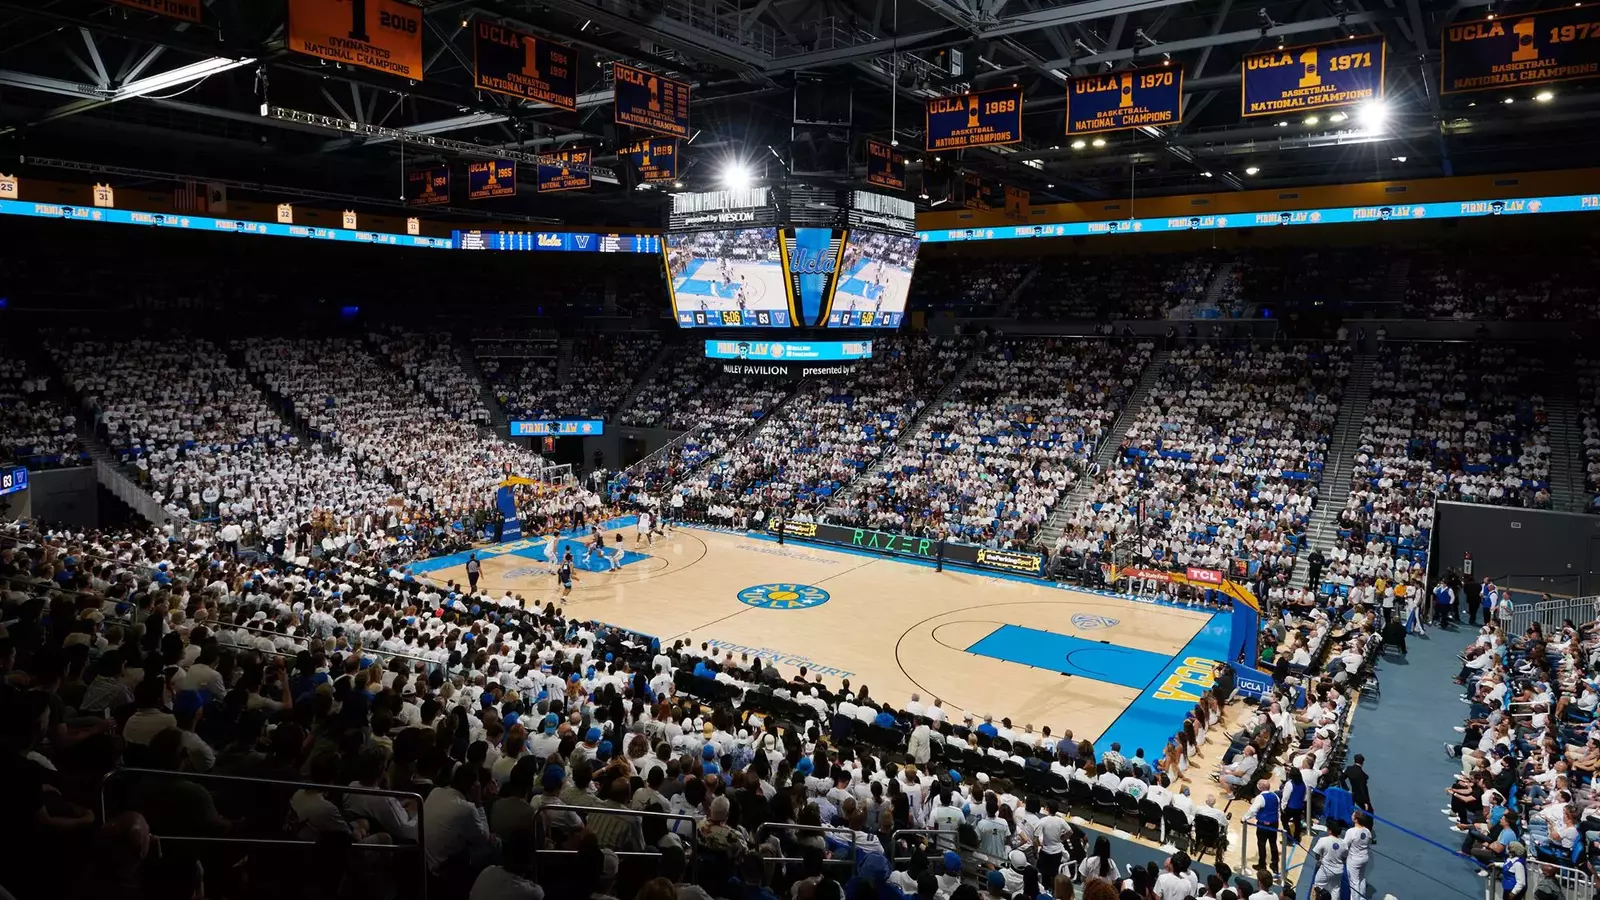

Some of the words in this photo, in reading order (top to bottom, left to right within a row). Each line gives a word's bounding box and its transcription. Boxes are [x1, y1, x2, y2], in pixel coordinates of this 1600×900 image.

[380, 10, 417, 34] 2018
[329, 37, 390, 59] GYMNASTICS
[1449, 21, 1505, 42] UCLA
[1511, 17, 1539, 62] 1
[304, 41, 354, 61] NATIONAL
[357, 54, 410, 75] CHAMPIONS
[479, 23, 519, 49] UCLA
[521, 35, 540, 79] 1
[1247, 51, 1293, 70] UCLA
[1299, 48, 1321, 88] 1
[1329, 52, 1372, 72] 1971
[1492, 58, 1558, 73] BASKETBALL
[507, 72, 551, 91] GYMNASTICS
[1454, 73, 1518, 88] NATIONAL
[1519, 63, 1598, 80] CHAMPIONS
[481, 74, 525, 94] NATIONAL
[527, 86, 574, 107] CHAMPIONS
[616, 67, 644, 86] UCLA
[648, 77, 660, 111] 1
[1075, 76, 1118, 94] UCLA
[1119, 71, 1134, 108] 1
[1140, 72, 1173, 89] 1970
[1282, 84, 1337, 98] BASKETBALL
[1251, 97, 1305, 112] NATIONAL
[1307, 88, 1372, 104] CHAMPIONS
[929, 97, 964, 115] UCLA
[967, 95, 980, 127] 1
[985, 99, 1015, 115] 1969
[1096, 106, 1150, 118] BASKETBALL
[621, 111, 652, 126] NATIONAL
[653, 119, 686, 134] CHAMPIONS
[1075, 118, 1116, 131] NATIONAL
[1122, 111, 1172, 125] CHAMPIONS
[935, 135, 967, 147] NATIONAL
[970, 131, 1011, 144] CHAMPIONS
[951, 126, 994, 136] BASKETBALL
[572, 153, 587, 163] 1967
[471, 162, 488, 172] UCLA
[488, 161, 497, 184] 1
[498, 168, 513, 178] 1965
[0, 183, 13, 191] 25
[433, 176, 447, 187] 1964
[703, 190, 730, 211] PAULEY
[1461, 202, 1493, 213] PIRNIA
[1504, 200, 1525, 211] LAW
[73, 207, 89, 217] LAW
[685, 214, 709, 225] presented
[710, 213, 718, 222] by
[718, 212, 755, 222] WESCOM
[1290, 212, 1308, 221] LAW
[1353, 208, 1382, 219] PIRNIA
[1392, 206, 1410, 217] LAW
[788, 248, 837, 275] Ucla
[723, 311, 740, 323] 5:06
[759, 313, 769, 324] 63
[750, 343, 769, 355] LAW
[744, 366, 788, 375] PAVILION
[803, 365, 842, 377] presented
[842, 366, 850, 375] by
[519, 423, 549, 433] PIRNIA
[560, 422, 578, 432] LAW
[3, 474, 12, 488] 63
[853, 529, 930, 555] RAZER
[1191, 570, 1217, 581] TCL
[707, 638, 783, 662] WOODEN
[784, 659, 856, 679] COURT
[1152, 656, 1220, 703] UCLA
[1241, 680, 1261, 692] UCLA
